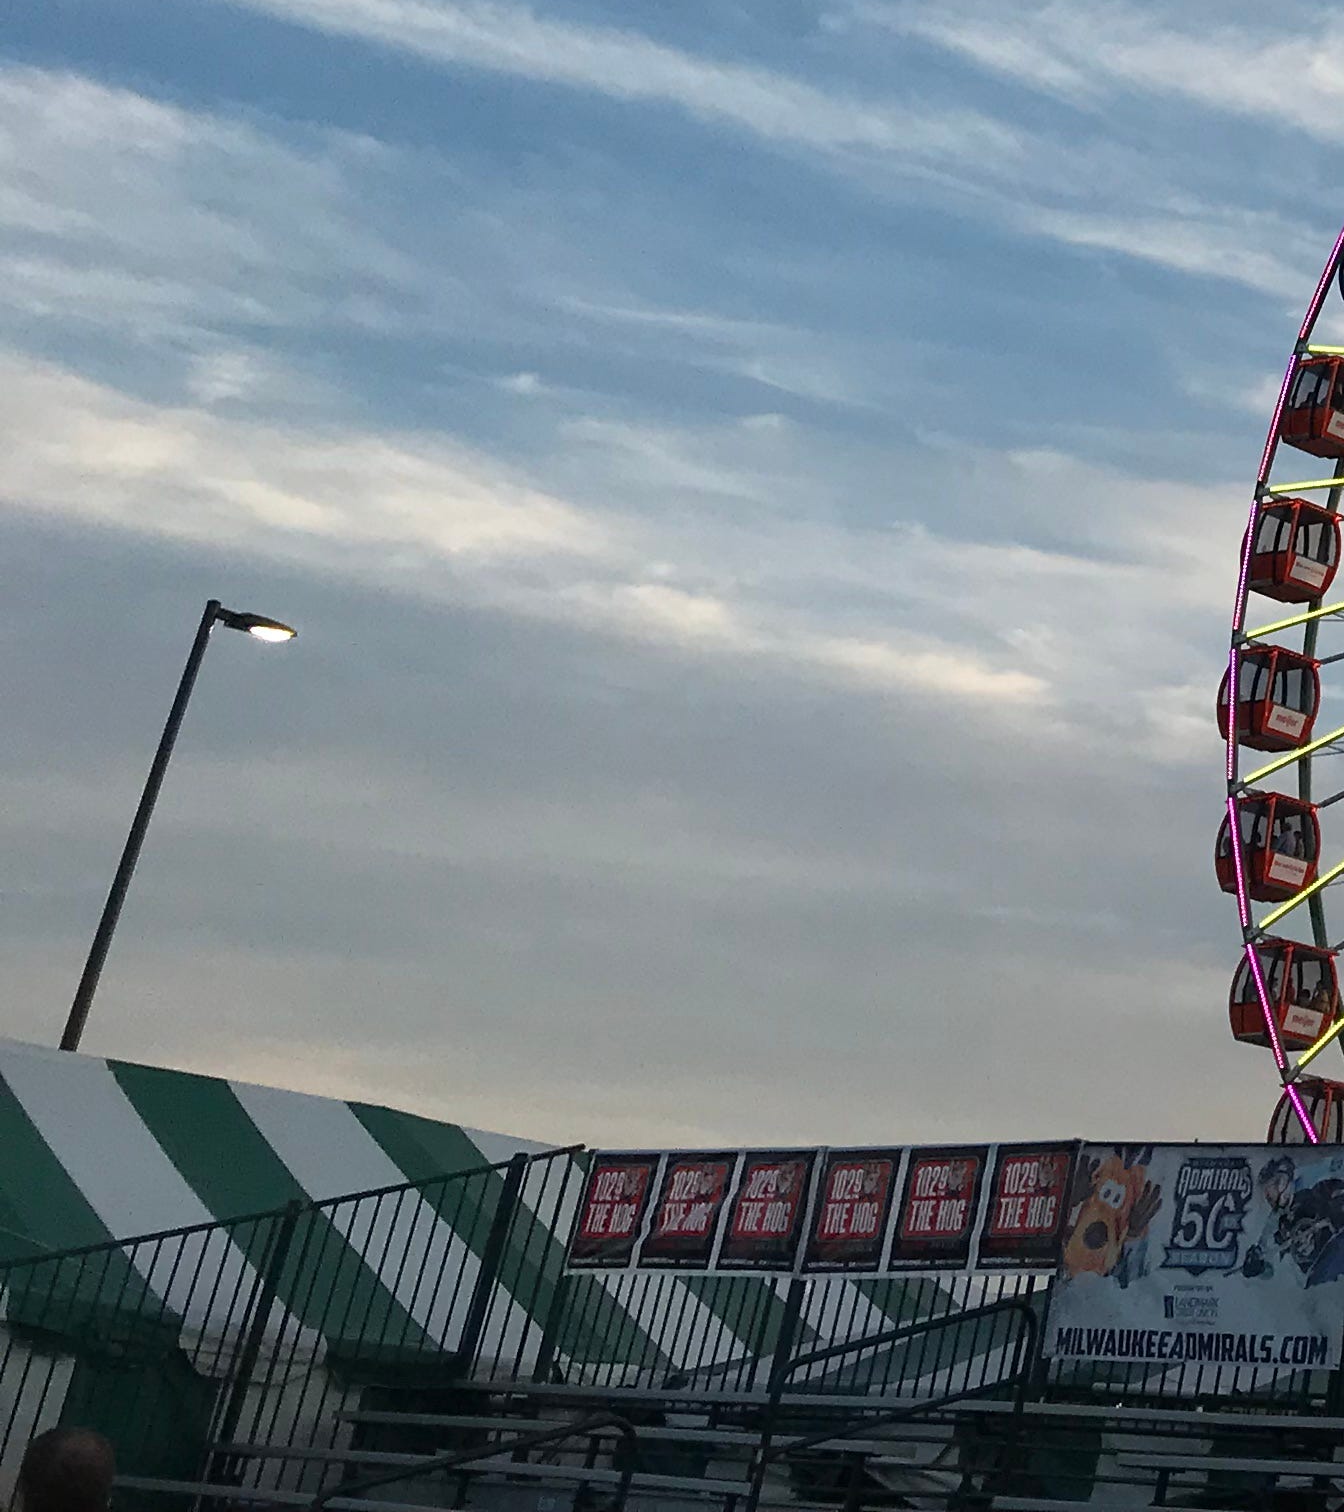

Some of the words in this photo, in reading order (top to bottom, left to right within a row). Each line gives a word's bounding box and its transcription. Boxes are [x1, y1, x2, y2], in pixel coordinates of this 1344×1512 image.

[830, 1169, 864, 1200] 1029
[915, 1166, 948, 1197] 1029
[1004, 1162, 1039, 1194] 1029
[1177, 1164, 1252, 1201] ADMIRALS
[824, 1203, 849, 1233] THE
[849, 1202, 878, 1233] HOG
[909, 1201, 936, 1231] THE
[936, 1199, 966, 1231] HOG
[997, 1197, 1023, 1228] THE
[1025, 1196, 1056, 1228] HOG
[1055, 1328, 1328, 1365] MILWAUKEEADMIRALS.COM
